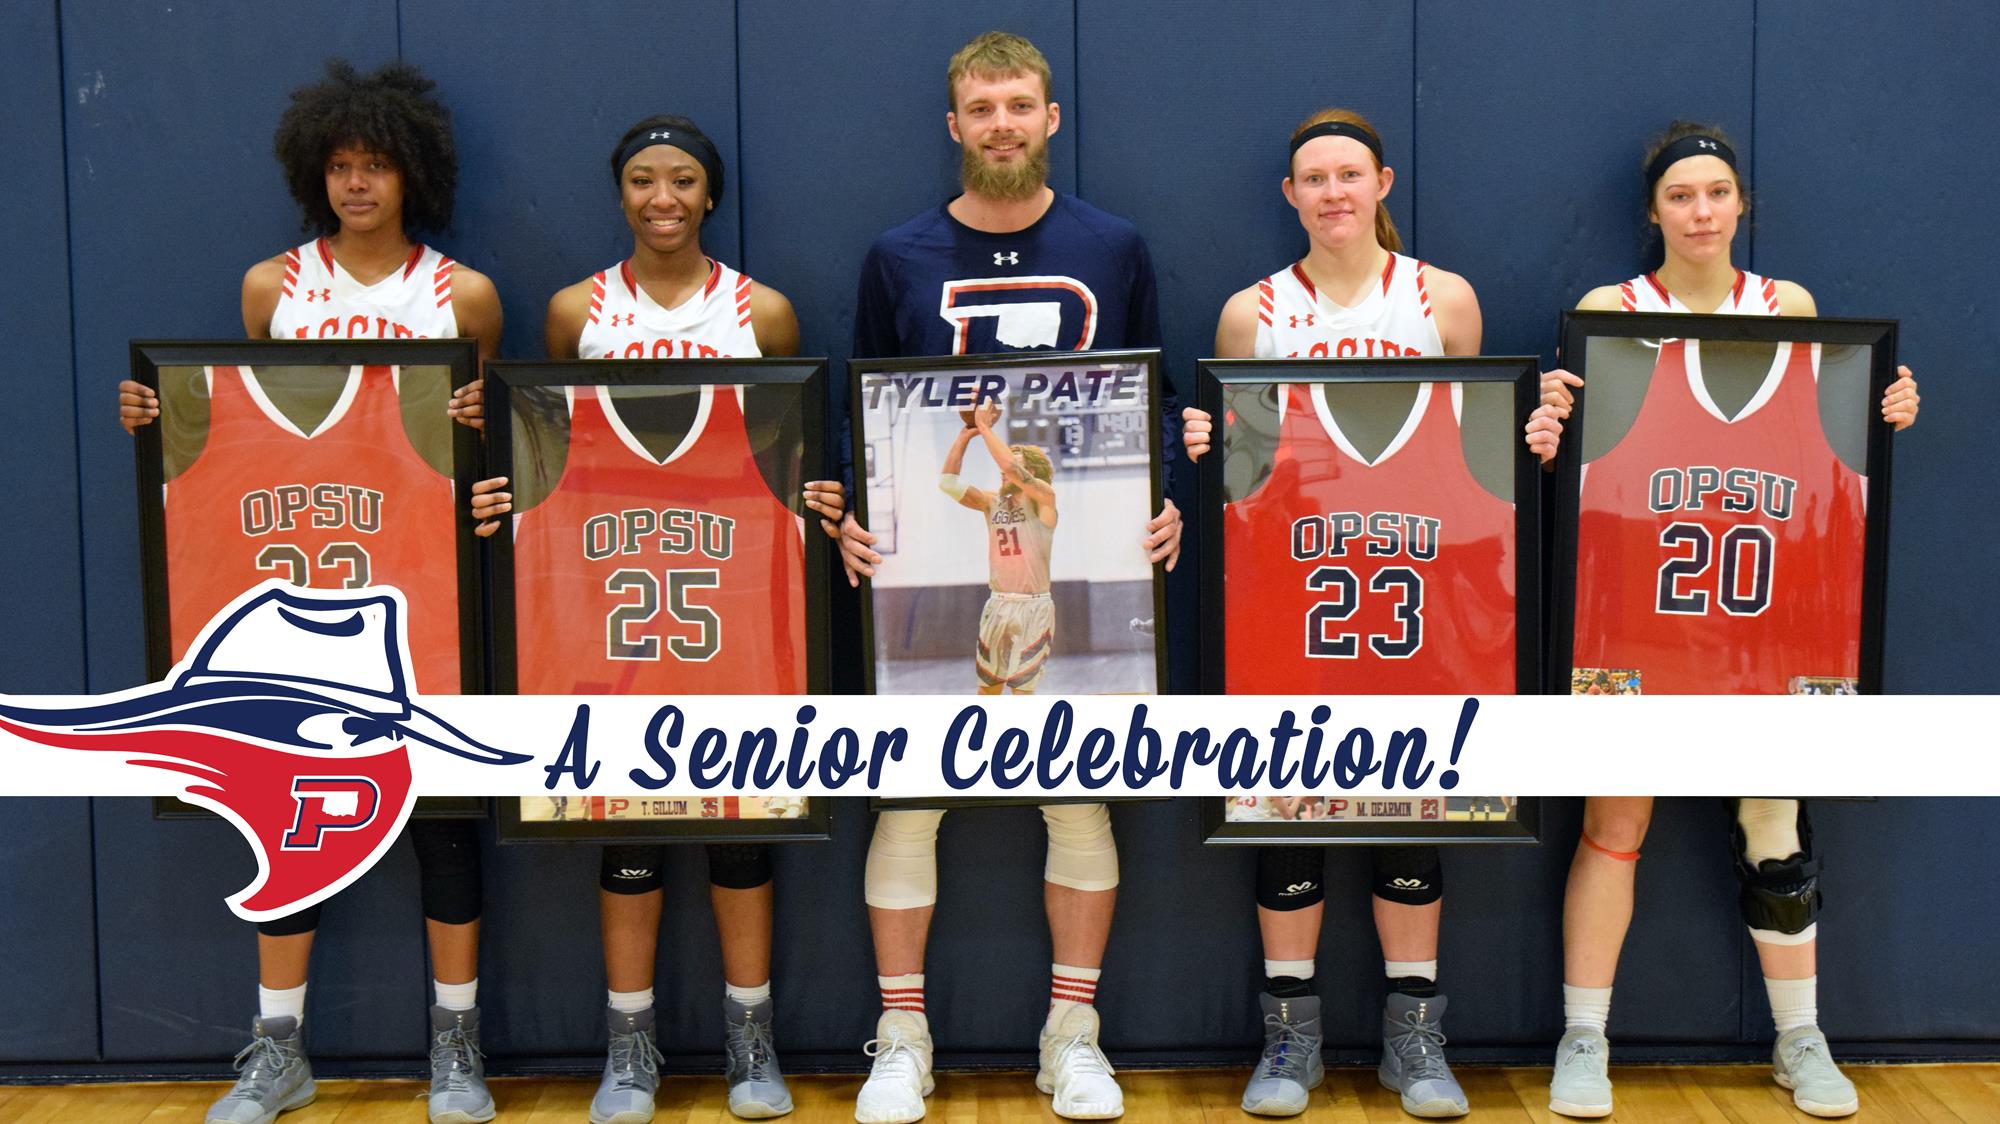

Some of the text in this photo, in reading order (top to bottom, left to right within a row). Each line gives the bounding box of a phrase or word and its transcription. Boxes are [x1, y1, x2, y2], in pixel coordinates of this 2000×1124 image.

[866, 368, 1144, 413] TYLER PATE
[240, 483, 384, 537] OPSU
[1648, 466, 1797, 521] OPSU
[583, 508, 735, 561] OPSU
[996, 526, 1022, 557] 21
[1291, 511, 1441, 562] OPSU
[1655, 521, 1775, 617] 20
[605, 568, 721, 662] 25
[1305, 565, 1424, 659] 23
[641, 797, 719, 817] T. GILLUM 35
[1356, 799, 1439, 820] M. DEARMIN 23
